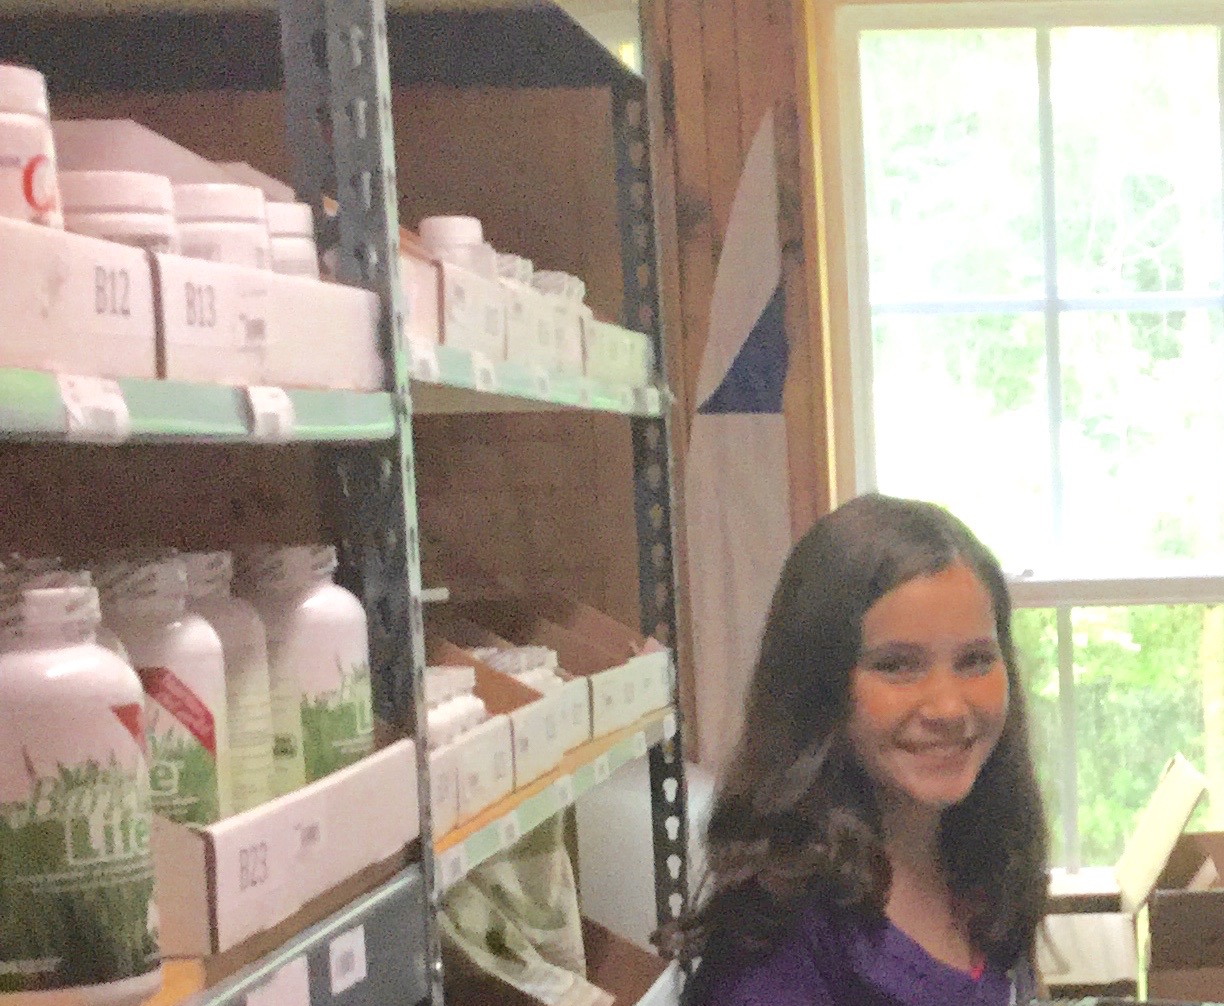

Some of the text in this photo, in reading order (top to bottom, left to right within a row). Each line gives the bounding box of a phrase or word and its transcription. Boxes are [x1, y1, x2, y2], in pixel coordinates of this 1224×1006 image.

[94, 265, 131, 317] B12
[184, 281, 217, 327] B13
[239, 841, 269, 891] B23
